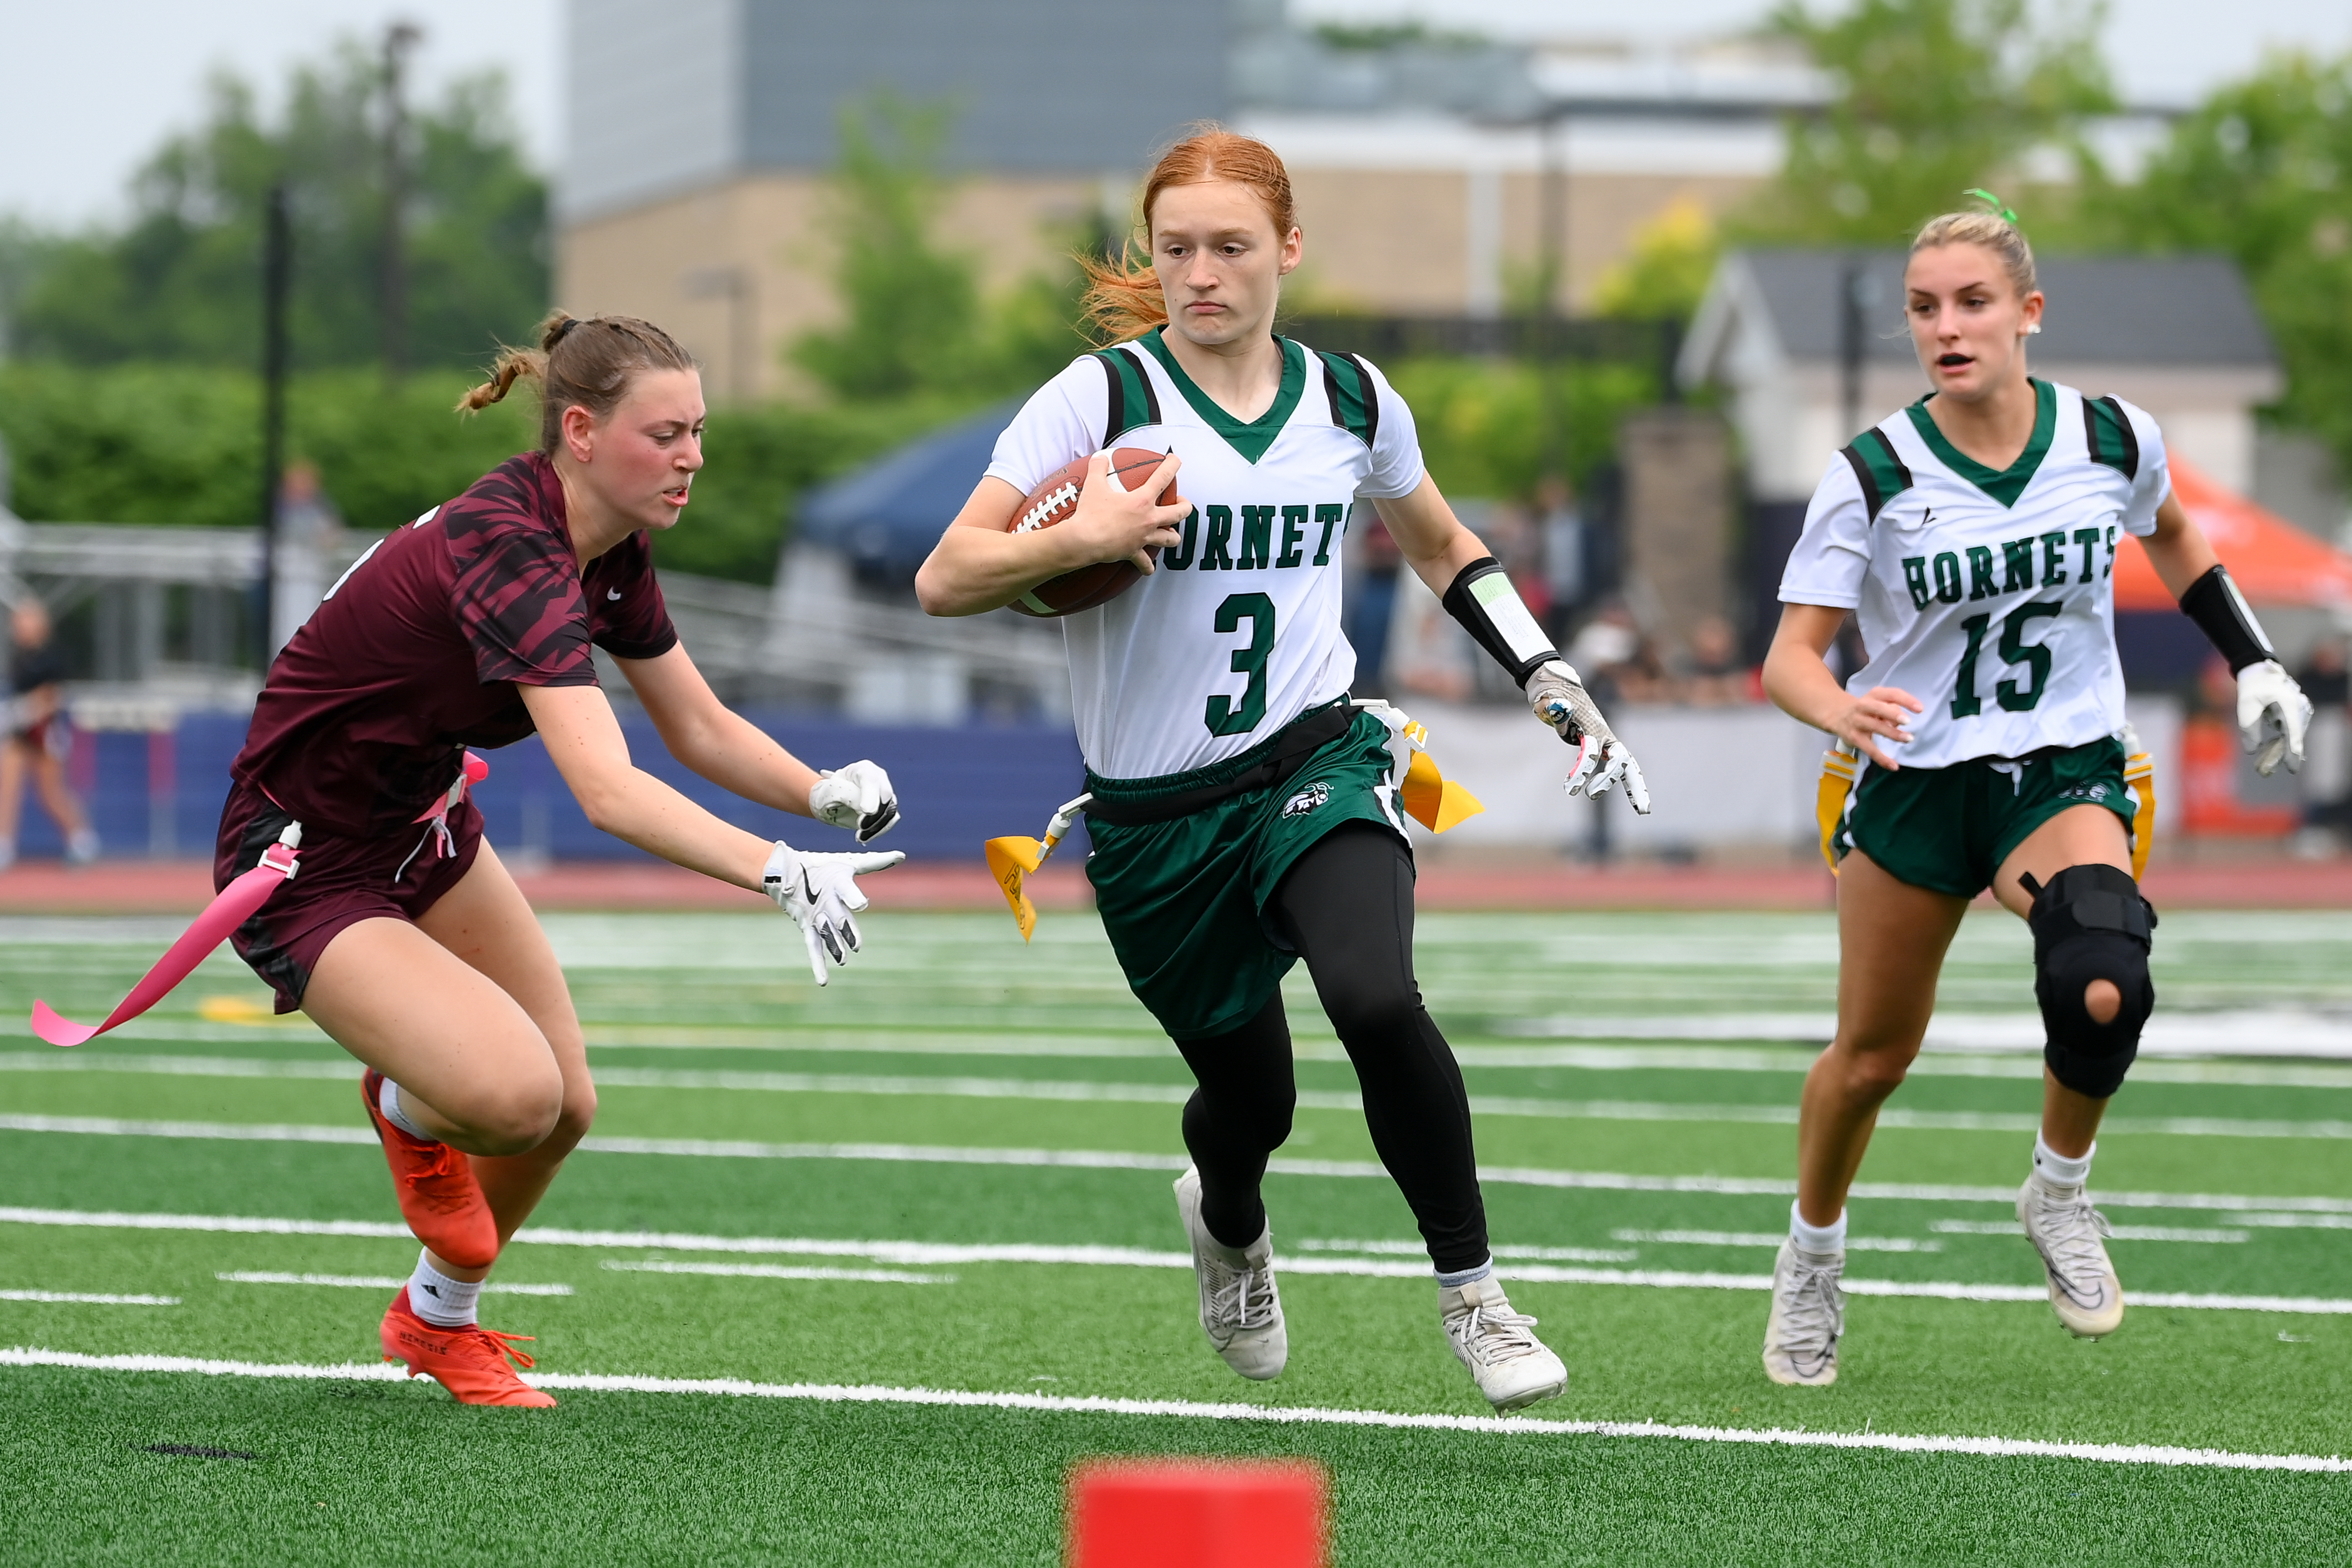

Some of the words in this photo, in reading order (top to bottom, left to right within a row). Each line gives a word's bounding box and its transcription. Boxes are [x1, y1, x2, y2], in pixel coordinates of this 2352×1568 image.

[1153, 502, 1353, 572] ORNET
[1204, 592, 1276, 739] 3
[1950, 600, 2063, 720] 15
